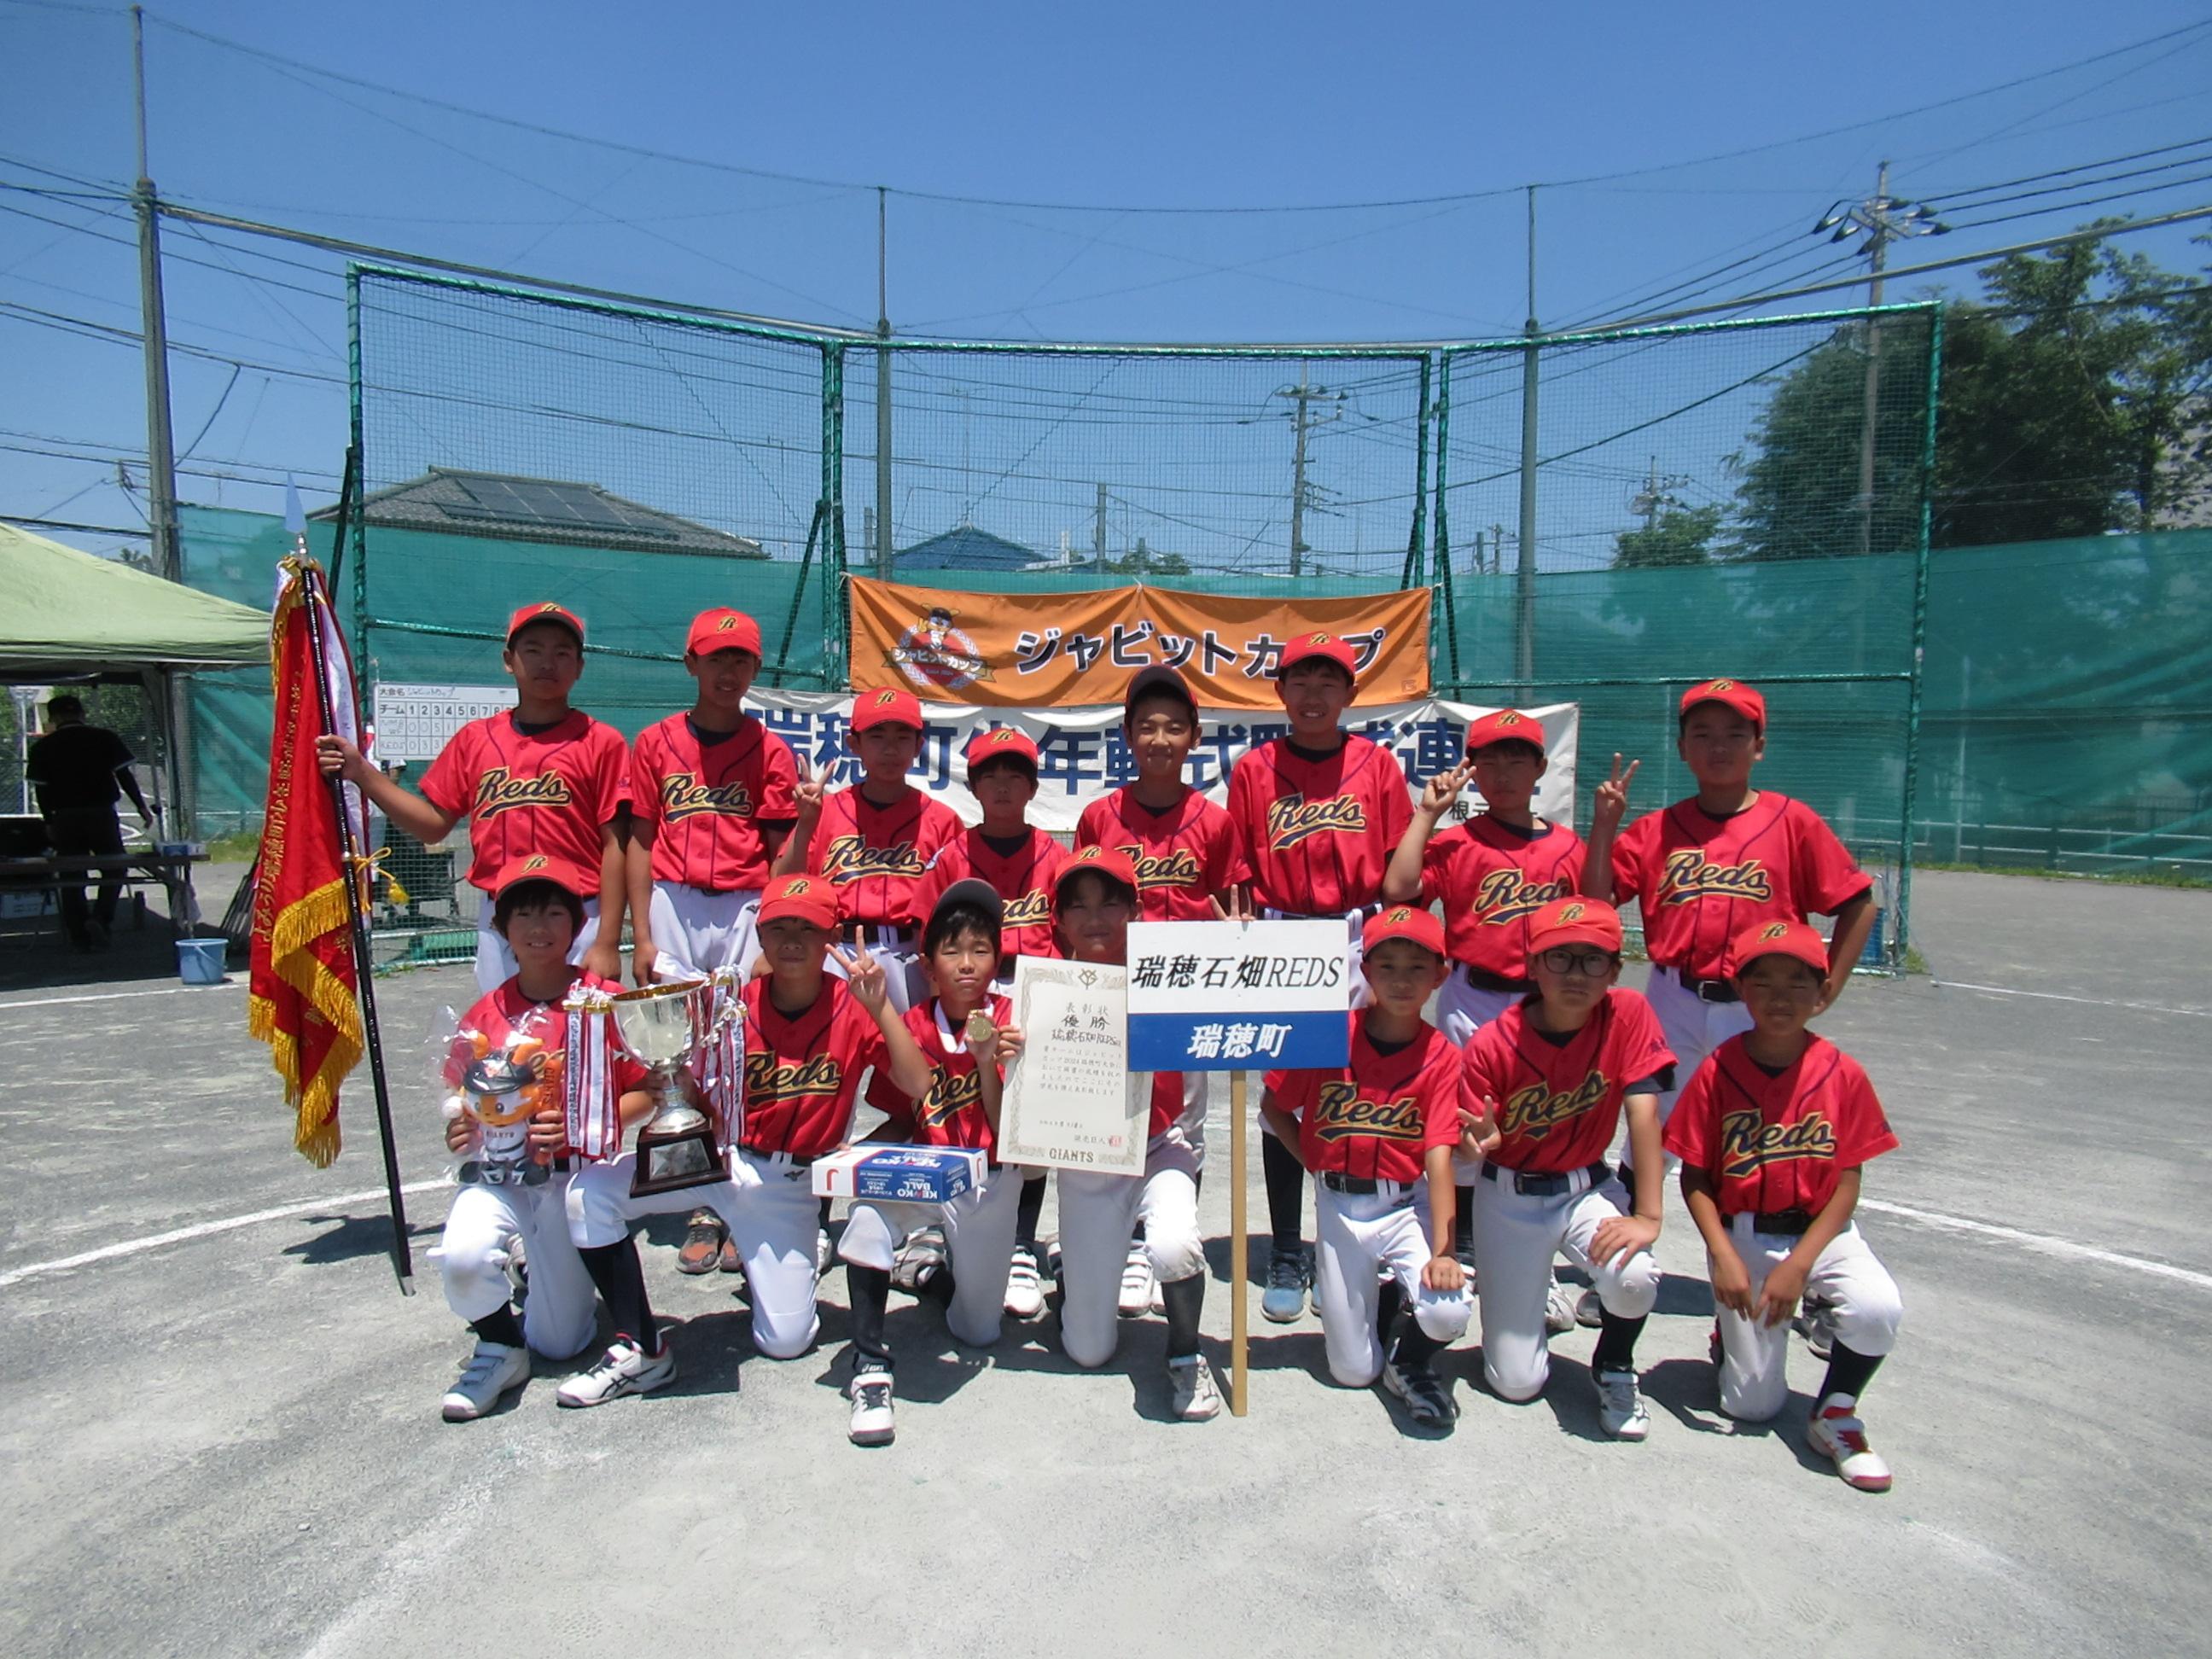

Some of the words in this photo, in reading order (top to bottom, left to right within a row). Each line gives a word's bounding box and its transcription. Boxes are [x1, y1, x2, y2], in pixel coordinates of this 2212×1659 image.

[893, 646, 982, 672] ジャビットカップ
[1016, 620, 1386, 680] ジャビットカプ
[380, 688, 405, 696] 大会名
[380, 704, 405, 714] チーム
[410, 706, 415, 714] 1
[422, 706, 428, 715] 2
[434, 706, 440, 715] 3
[445, 706, 452, 715] 4
[458, 706, 465, 715] 5
[469, 707, 476, 715] 6
[483, 707, 489, 715] 7
[474, 765, 573, 819] Reds
[662, 771, 754, 824] Reds
[1268, 792, 1366, 852] Reds
[821, 834, 926, 885] Reds
[1658, 849, 1773, 905] Reds
[1132, 955, 1344, 988] 瑞穂石畑REDS
[1062, 1015, 1110, 1030] 優勝
[1187, 1023, 1292, 1058] 瑞穂町
[747, 1051, 841, 1106] Reds
[1314, 1080, 1425, 1143] Reds
[1049, 1148, 1094, 1162] GIANTS
[1722, 1109, 1837, 1178] Reds
